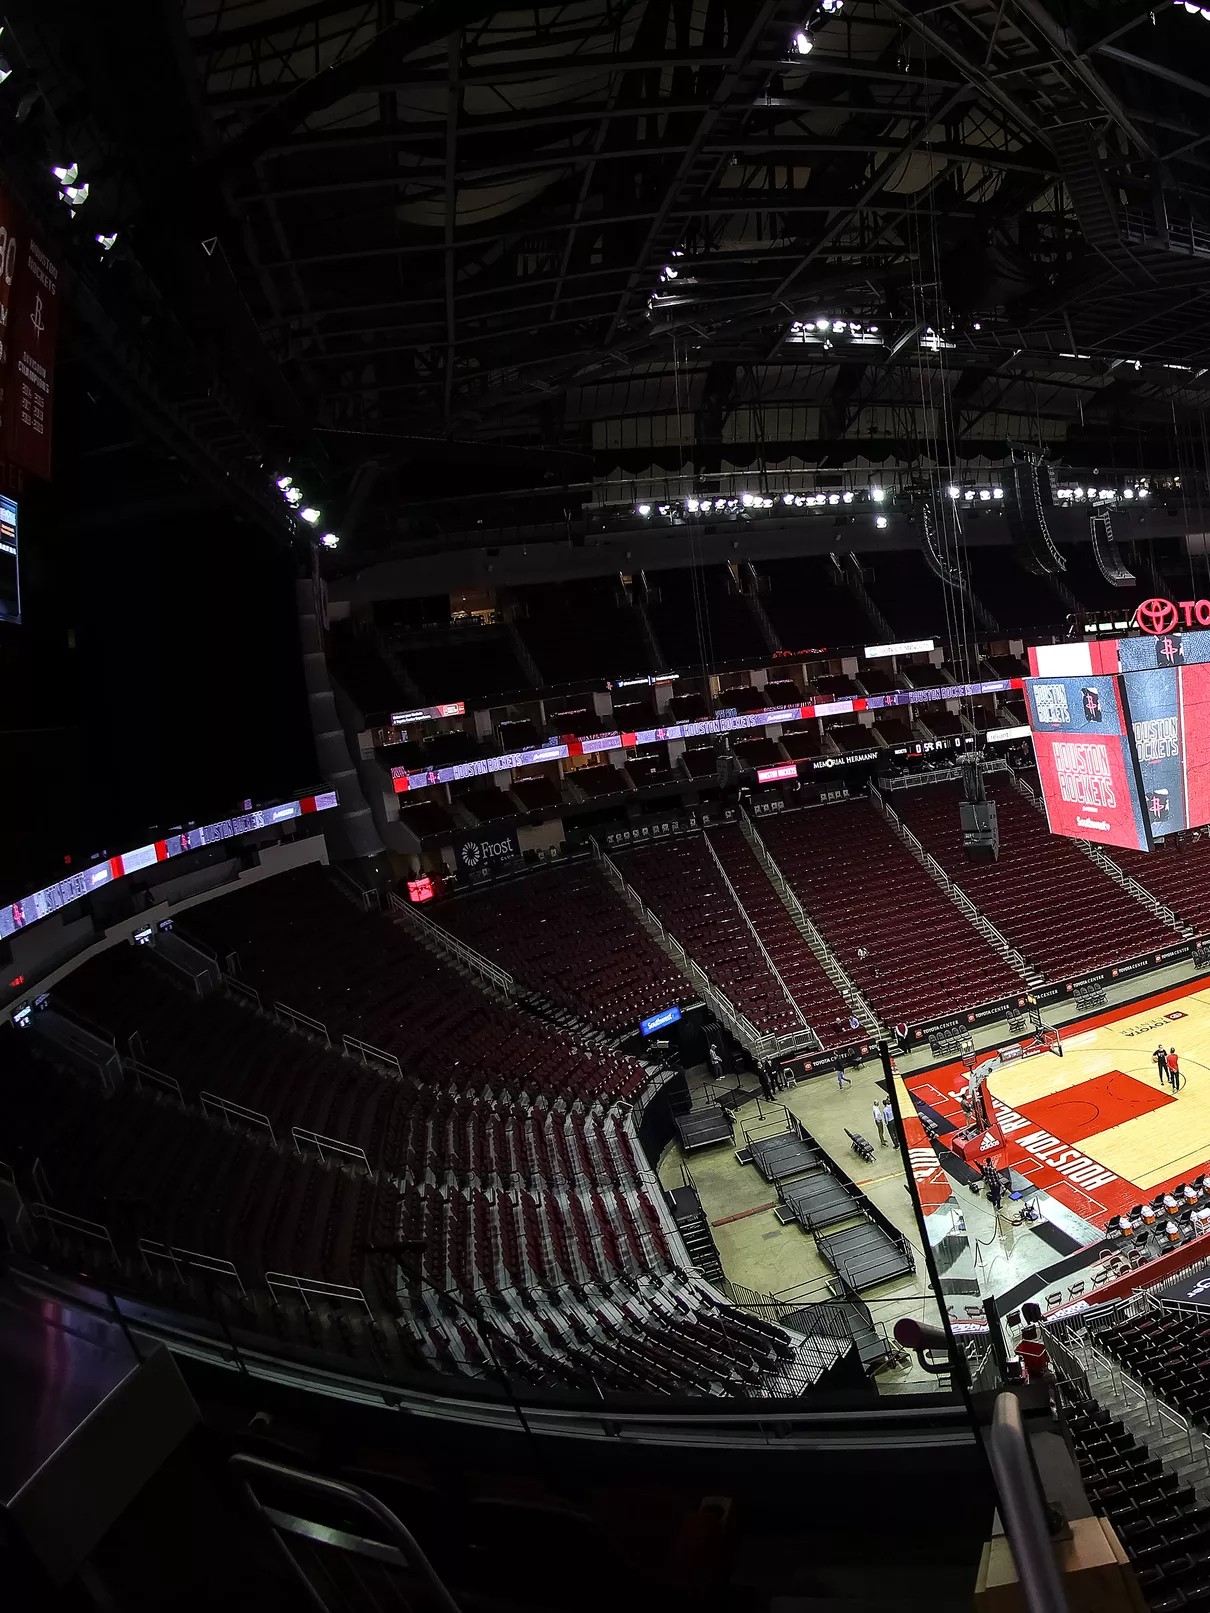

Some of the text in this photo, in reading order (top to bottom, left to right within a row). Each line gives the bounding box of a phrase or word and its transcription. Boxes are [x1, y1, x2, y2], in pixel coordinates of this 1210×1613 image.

[1033, 684, 1067, 705] HOUSTON
[1037, 703, 1070, 724] ROCKETS
[683, 718, 721, 738] HOUSTON
[721, 714, 757, 734] ROCKETS
[1052, 741, 1112, 777] HOUSTON
[1135, 736, 1179, 763] OCKETS
[453, 752, 523, 781] HOUSTON ROCKETS
[813, 752, 878, 769] MEMORIAL HERMANN
[1058, 772, 1117, 809] ROCKETS
[480, 838, 514, 860] Frost
[1161, 946, 1190, 960] TOYOTA CENTER
[1119, 960, 1149, 975] TOYOTA CENTER
[1073, 974, 1105, 989] TOYOTA CENTER
[1040, 989, 1059, 1000] CENTER
[976, 1004, 1010, 1019] TOYOTA CENTER
[923, 1019, 960, 1035] TOYOTA CENTER
[1124, 1020, 1171, 1037] TOYOTA
[980, 1140, 1000, 1152] adidas
[1015, 1129, 1119, 1192] HOUSTON
